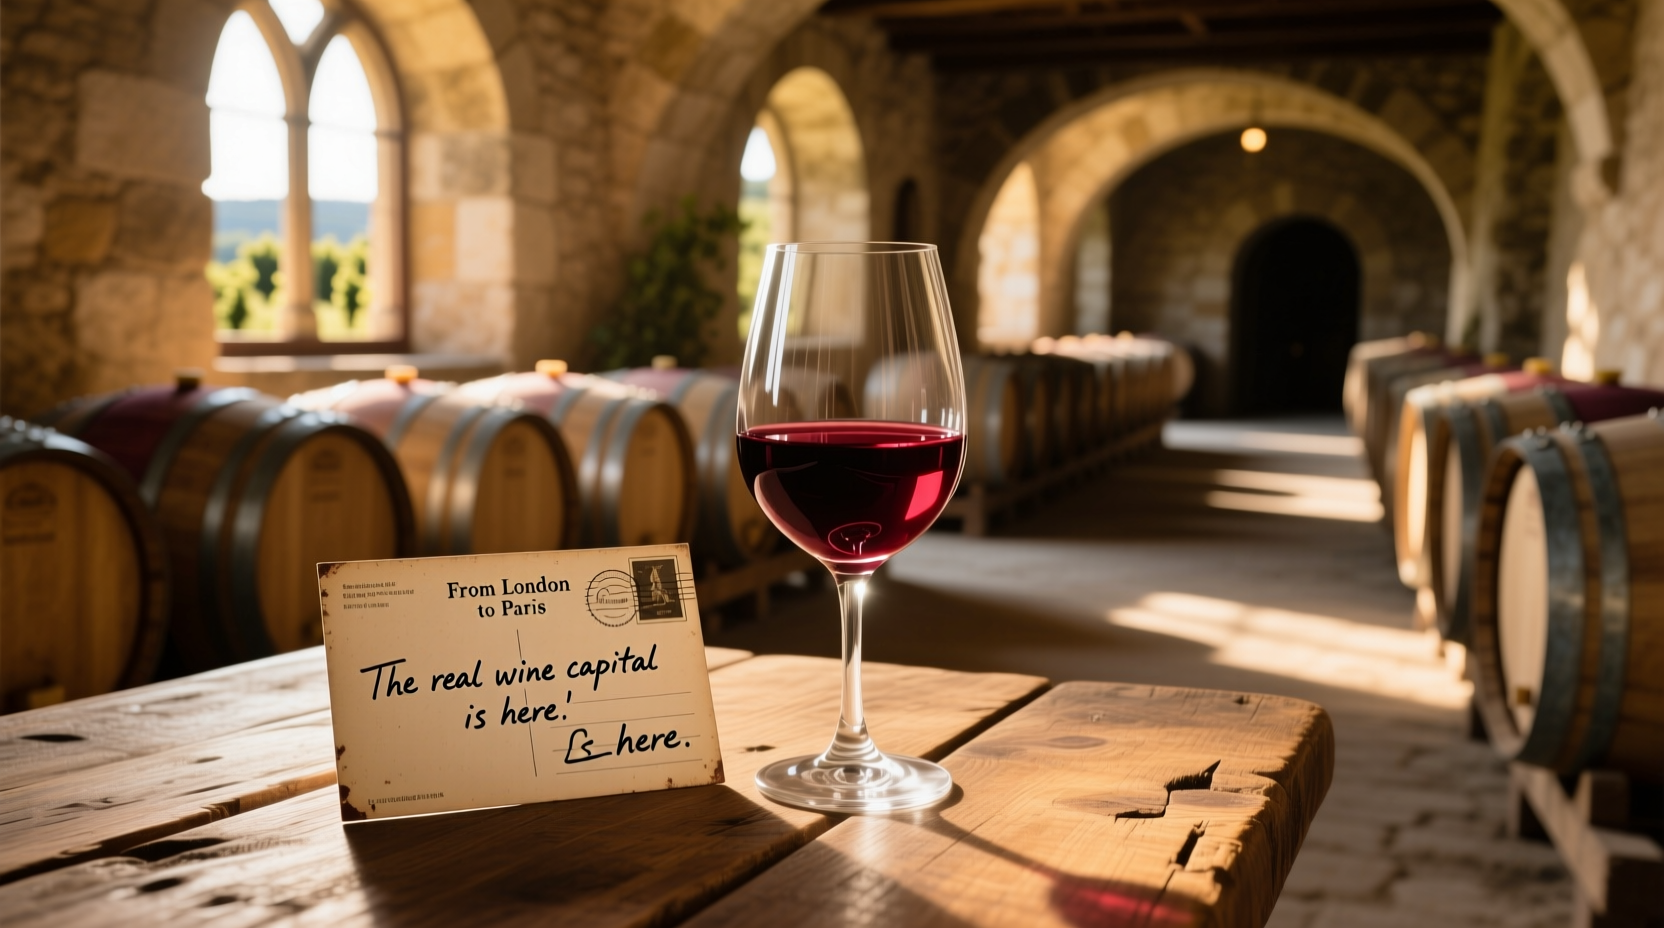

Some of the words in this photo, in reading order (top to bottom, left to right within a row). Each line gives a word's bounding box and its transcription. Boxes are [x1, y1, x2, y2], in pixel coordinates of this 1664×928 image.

[446, 581, 496, 599] From
[502, 575, 570, 596] London
[477, 604, 495, 618] to
[501, 598, 546, 616] Paris
[359, 658, 419, 701] The
[431, 659, 483, 692] real
[495, 659, 556, 687] wine
[566, 643, 658, 691] capital
[464, 704, 486, 730] is
[616, 723, 690, 756] here.
